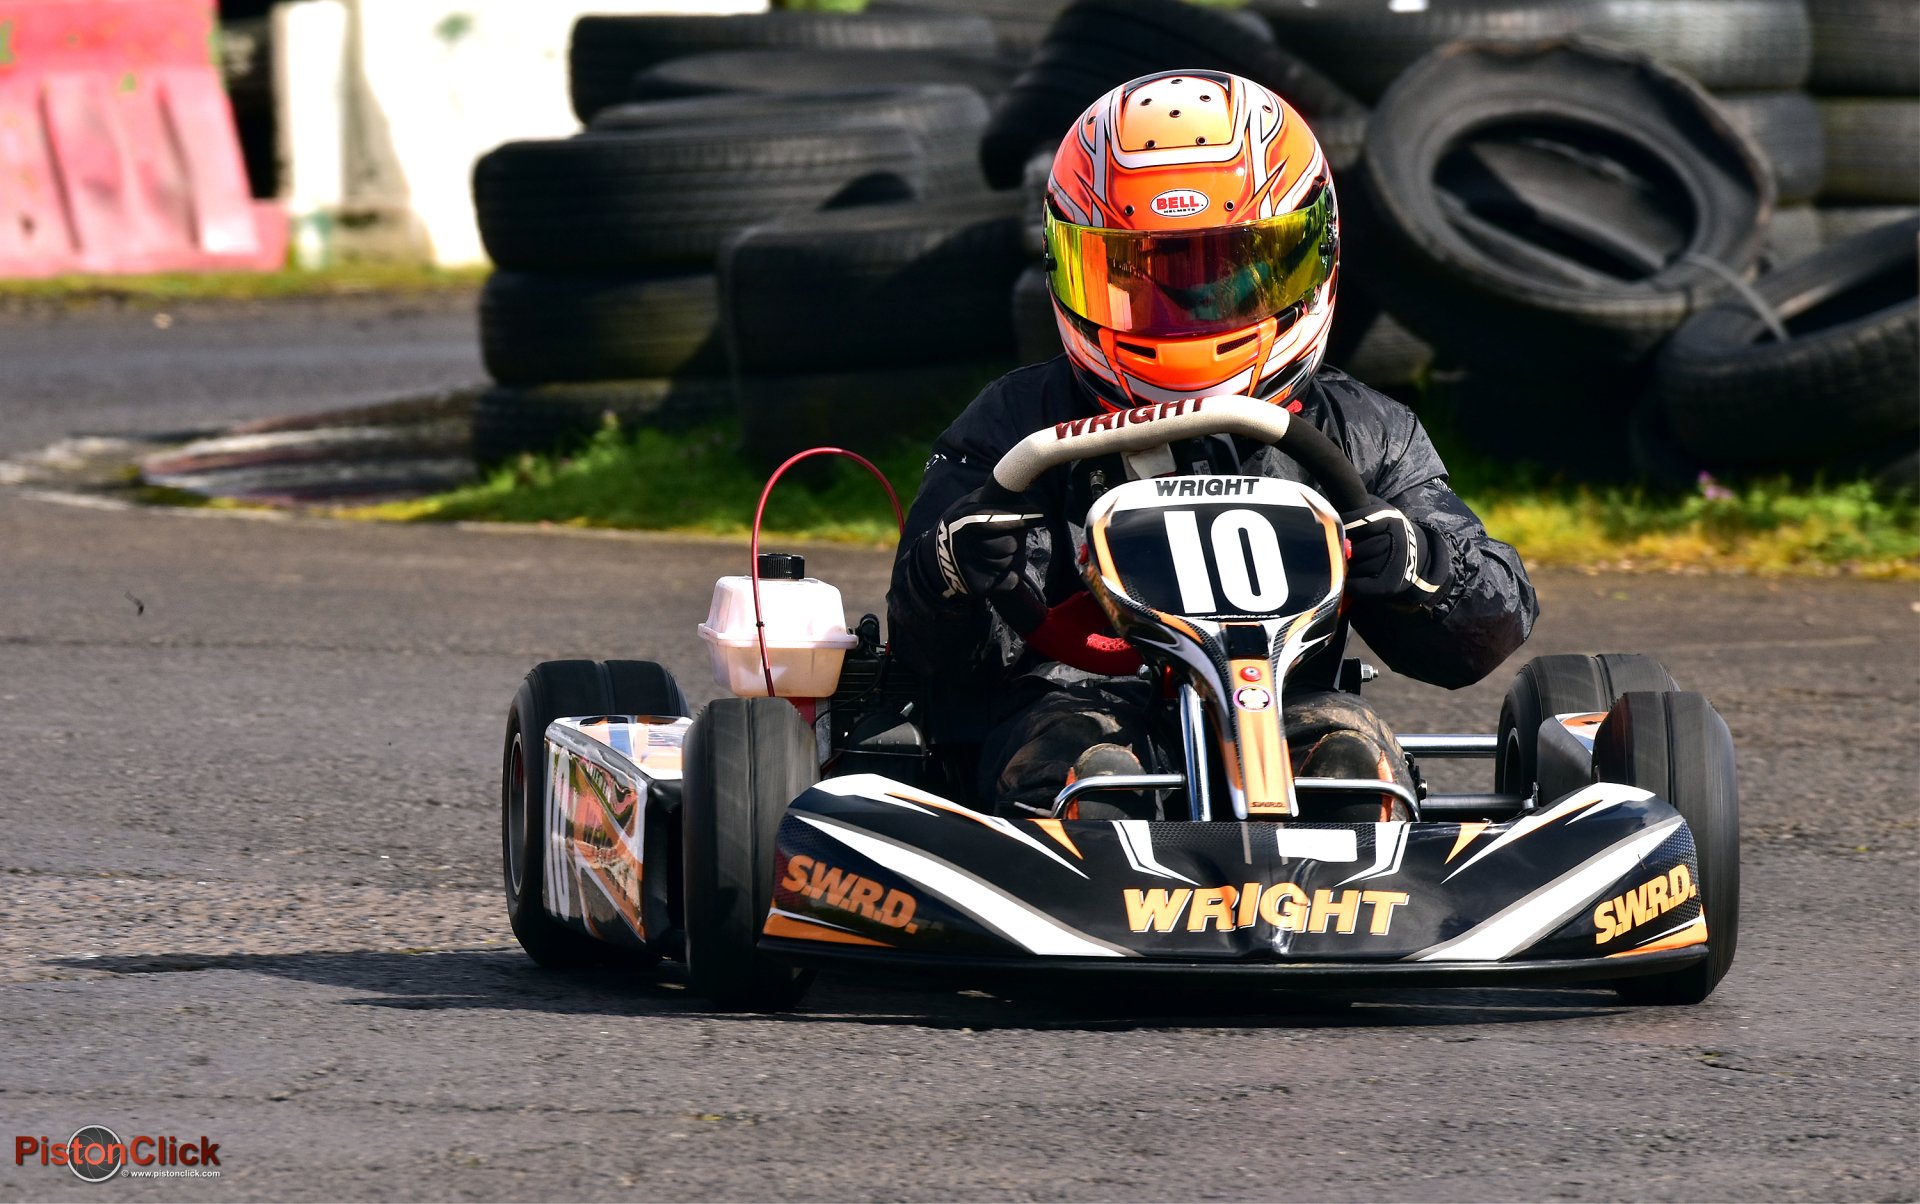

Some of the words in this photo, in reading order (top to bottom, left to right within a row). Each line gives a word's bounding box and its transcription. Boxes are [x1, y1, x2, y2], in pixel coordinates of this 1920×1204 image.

[1156, 195, 1199, 210] BELL
[1155, 478, 1260, 497] WRIGHT
[1163, 509, 1289, 614] 10
[781, 854, 918, 934] S.W.R.D.
[1123, 882, 1410, 936] WRIGHT
[1593, 864, 1697, 945] S.W.R.D.
